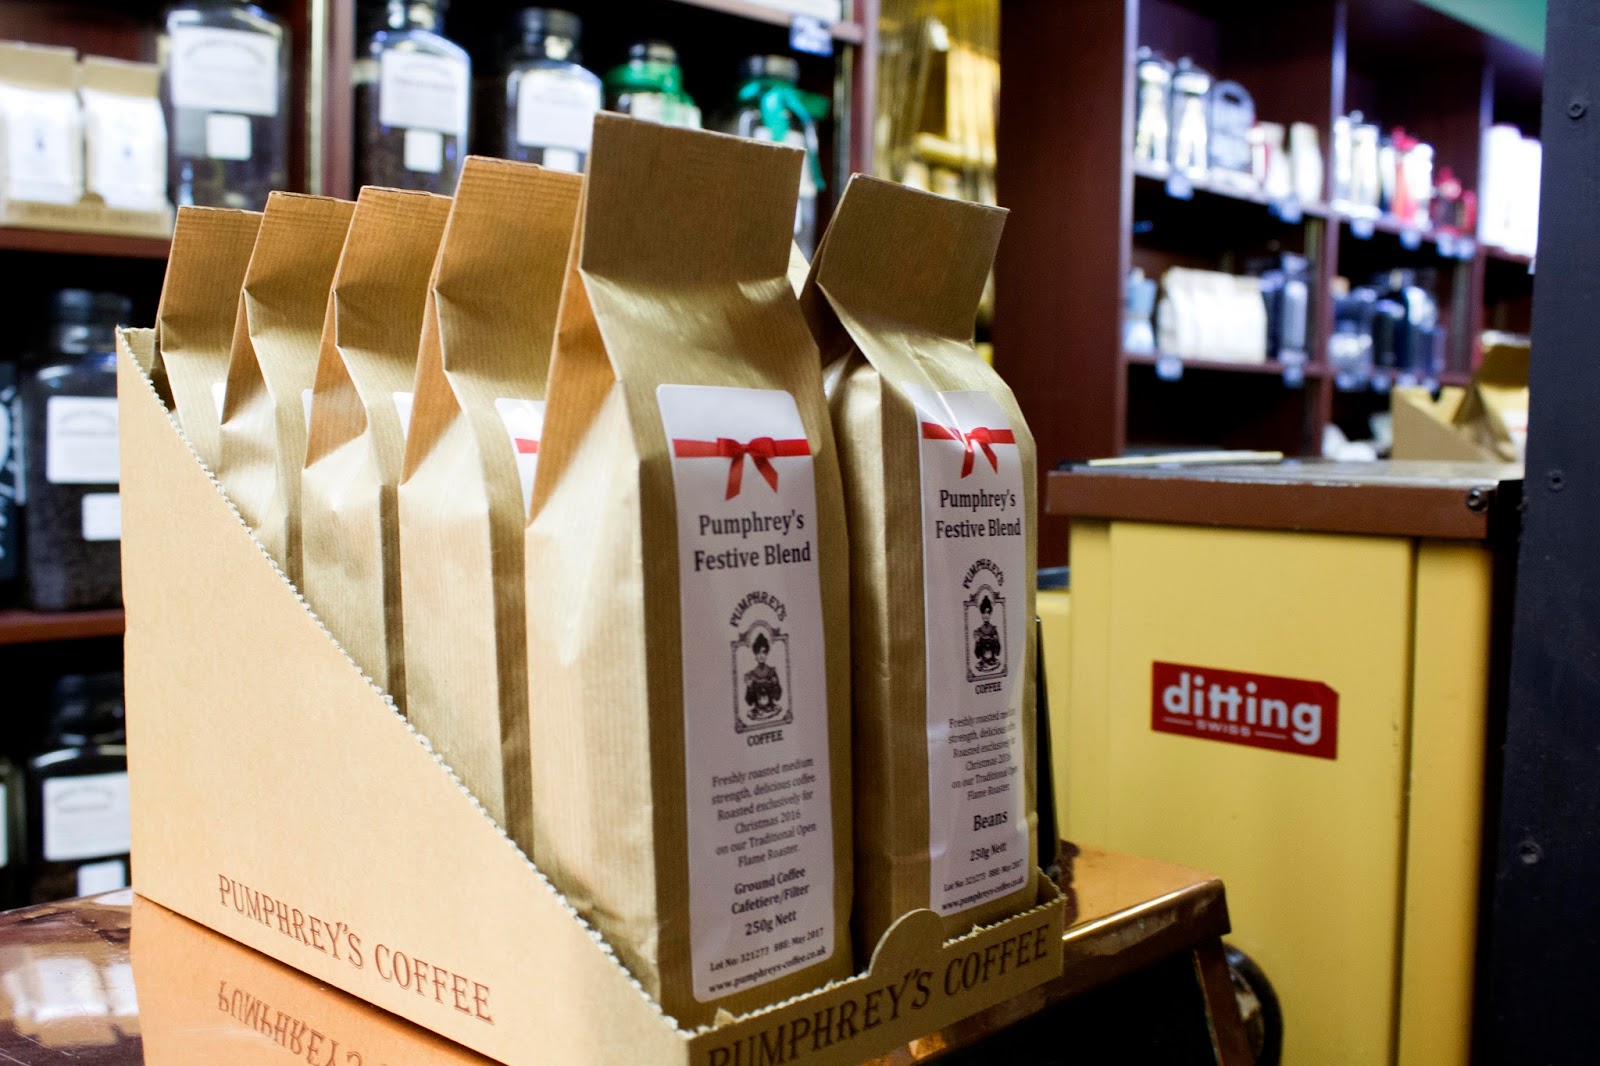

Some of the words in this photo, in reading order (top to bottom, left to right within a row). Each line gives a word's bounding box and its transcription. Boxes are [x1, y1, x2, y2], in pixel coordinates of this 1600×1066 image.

[940, 488, 1016, 512] Pumphrey's
[698, 509, 805, 538] Pumphrey's
[935, 520, 986, 539] Festive
[988, 517, 1022, 537] Blend
[693, 549, 760, 573] Festive
[763, 541, 812, 566] Blend
[963, 558, 1005, 590] PUMPHREY'S
[729, 591, 787, 628] PUMPHREY'S
[974, 682, 1003, 695] COFFEE
[1162, 671, 1322, 746] ditting
[746, 729, 784, 747] COFFEE
[1195, 718, 1251, 738] SWISS
[712, 771, 746, 788] Freshly
[748, 763, 780, 780] roasted
[781, 758, 814, 772] medium
[753, 781, 792, 796] delicious
[792, 773, 816, 787] coffee
[717, 802, 755, 821] Roasted
[756, 794, 801, 812] exclusively
[802, 790, 814, 801] for
[734, 817, 778, 834] Christmas
[780, 809, 801, 823] 2016
[973, 811, 1008, 831] Beans
[715, 845, 729, 856] on
[730, 841, 747, 853] our
[748, 826, 795, 848] Traditional
[796, 823, 817, 837] Open
[969, 847, 990, 861] 250g
[991, 842, 1008, 855] Nett
[738, 853, 766, 868] Flame
[767, 844, 799, 860] Roaster
[734, 874, 776, 895] Ground
[777, 867, 806, 884] Coffee
[744, 918, 774, 937] 250g
[774, 910, 798, 927] Nett
[218, 873, 364, 970] PUMPHREY'S
[375, 943, 495, 1025] COFFEE
[709, 961, 724, 972] Lot
[791, 935, 806, 946] May
[807, 927, 825, 941] 2017
[943, 924, 1049, 997] COFFEE
[708, 945, 827, 993] www.pumphreys-coffee.co.uk
